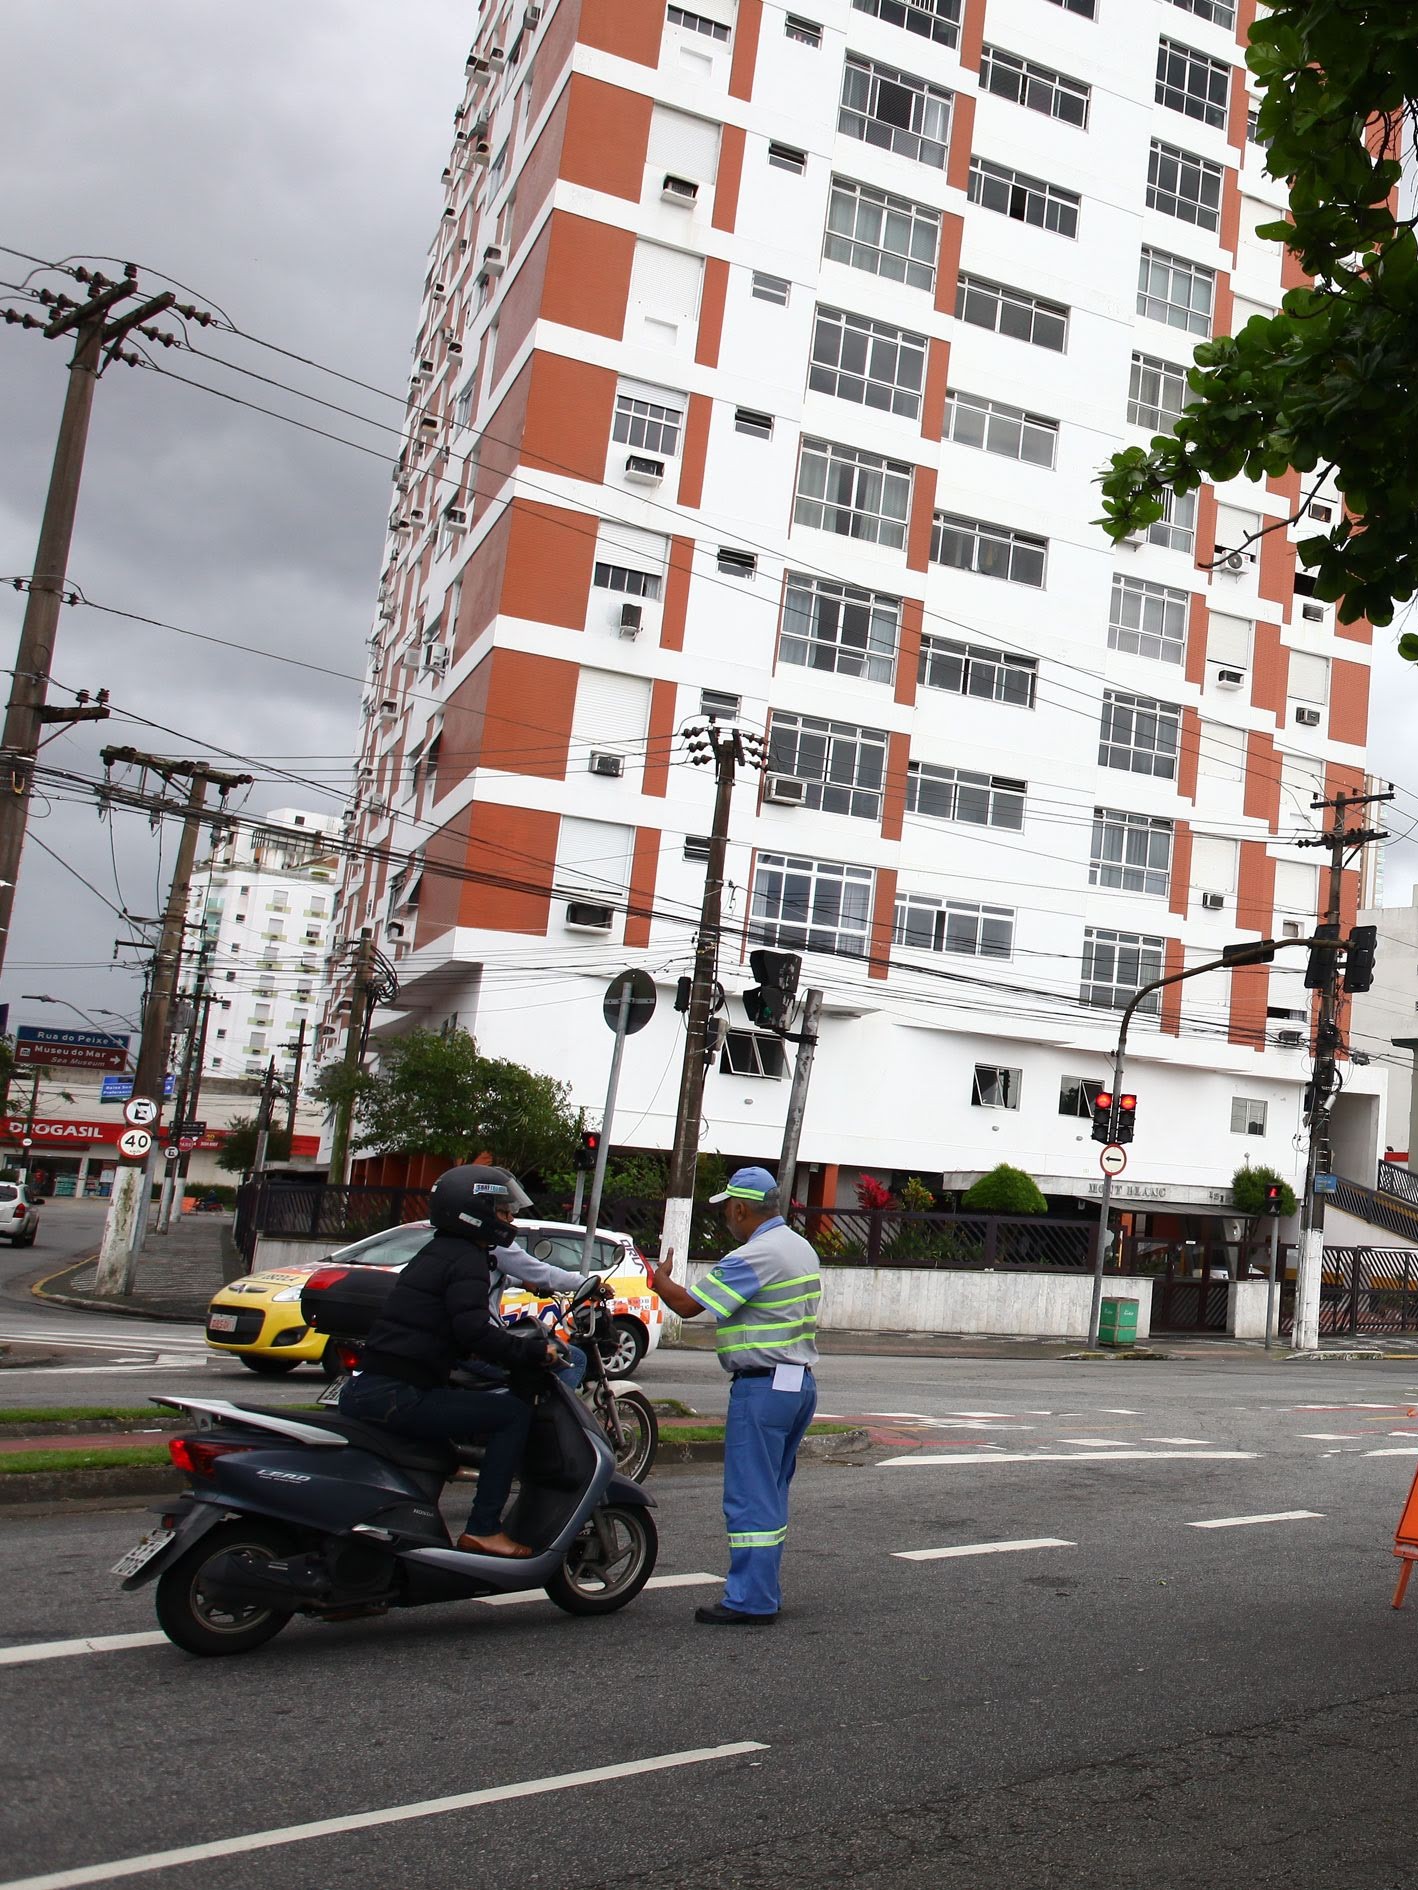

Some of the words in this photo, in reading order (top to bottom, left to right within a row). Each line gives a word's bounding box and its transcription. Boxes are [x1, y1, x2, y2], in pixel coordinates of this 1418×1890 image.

[37, 1031, 59, 1040] Rua
[62, 1033, 74, 1042] do
[77, 1035, 109, 1045] Peixe
[34, 1045, 69, 1056] Museu
[71, 1048, 84, 1057] do
[85, 1050, 107, 1058] Mar
[50, 1056, 68, 1064] Sea
[69, 1058, 106, 1067] Museum
[124, 1134, 149, 1148] 40
[256, 1469, 312, 1482] LEAD
